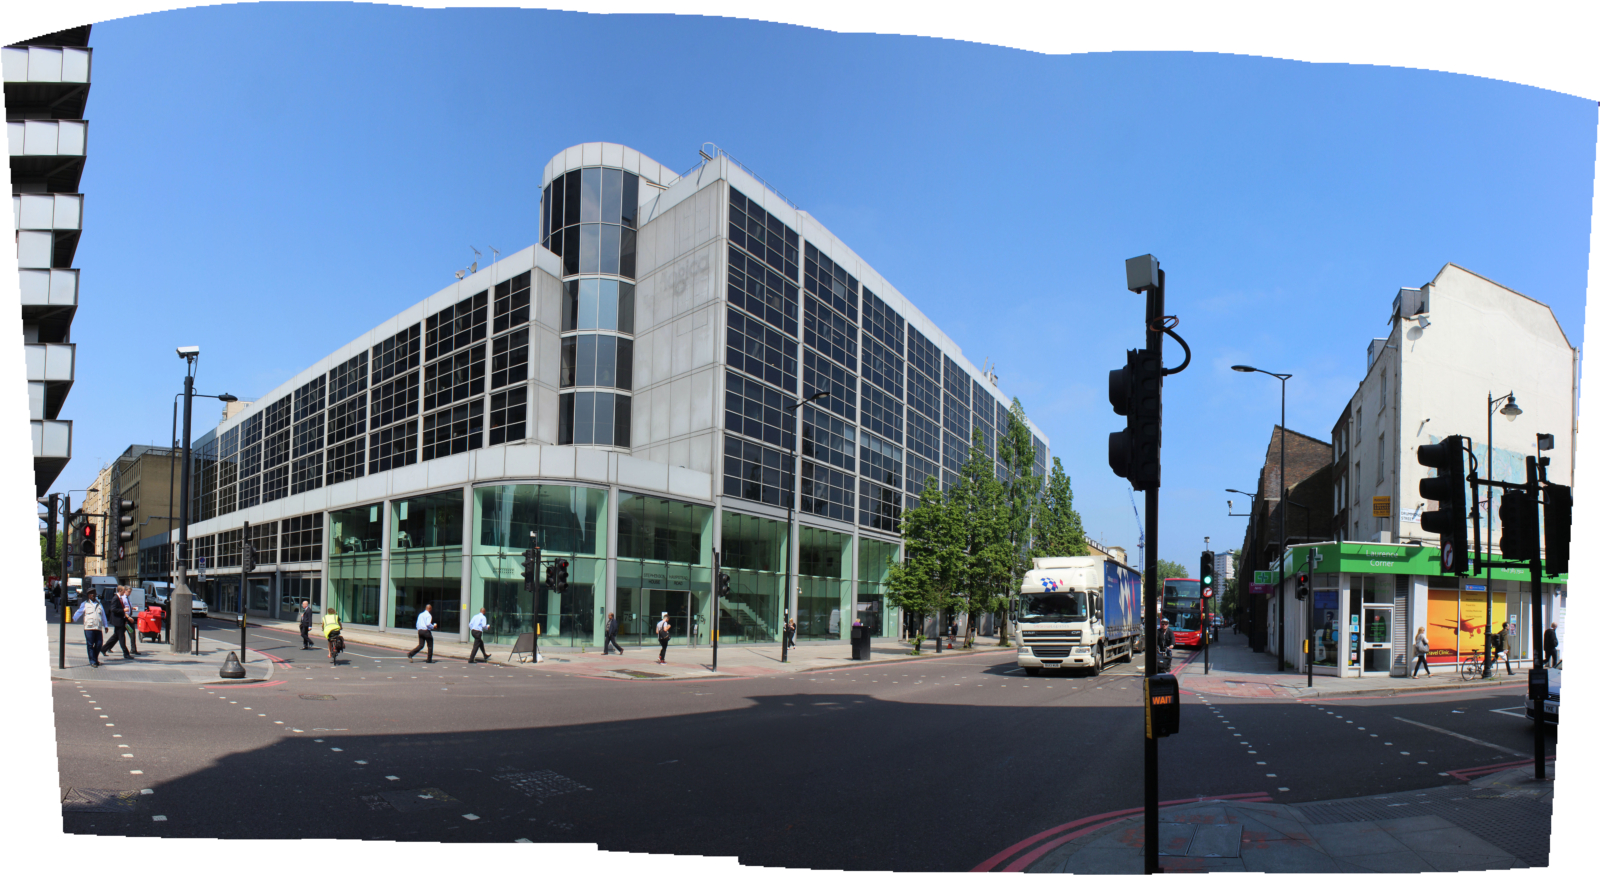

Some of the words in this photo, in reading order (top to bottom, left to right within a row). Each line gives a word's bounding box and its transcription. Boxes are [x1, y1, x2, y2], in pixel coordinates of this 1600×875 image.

[1366, 550, 1398, 558] Laurence
[1370, 559, 1394, 567] Corner
[624, 613, 633, 622] 75
[1152, 695, 1172, 705] WAIT
